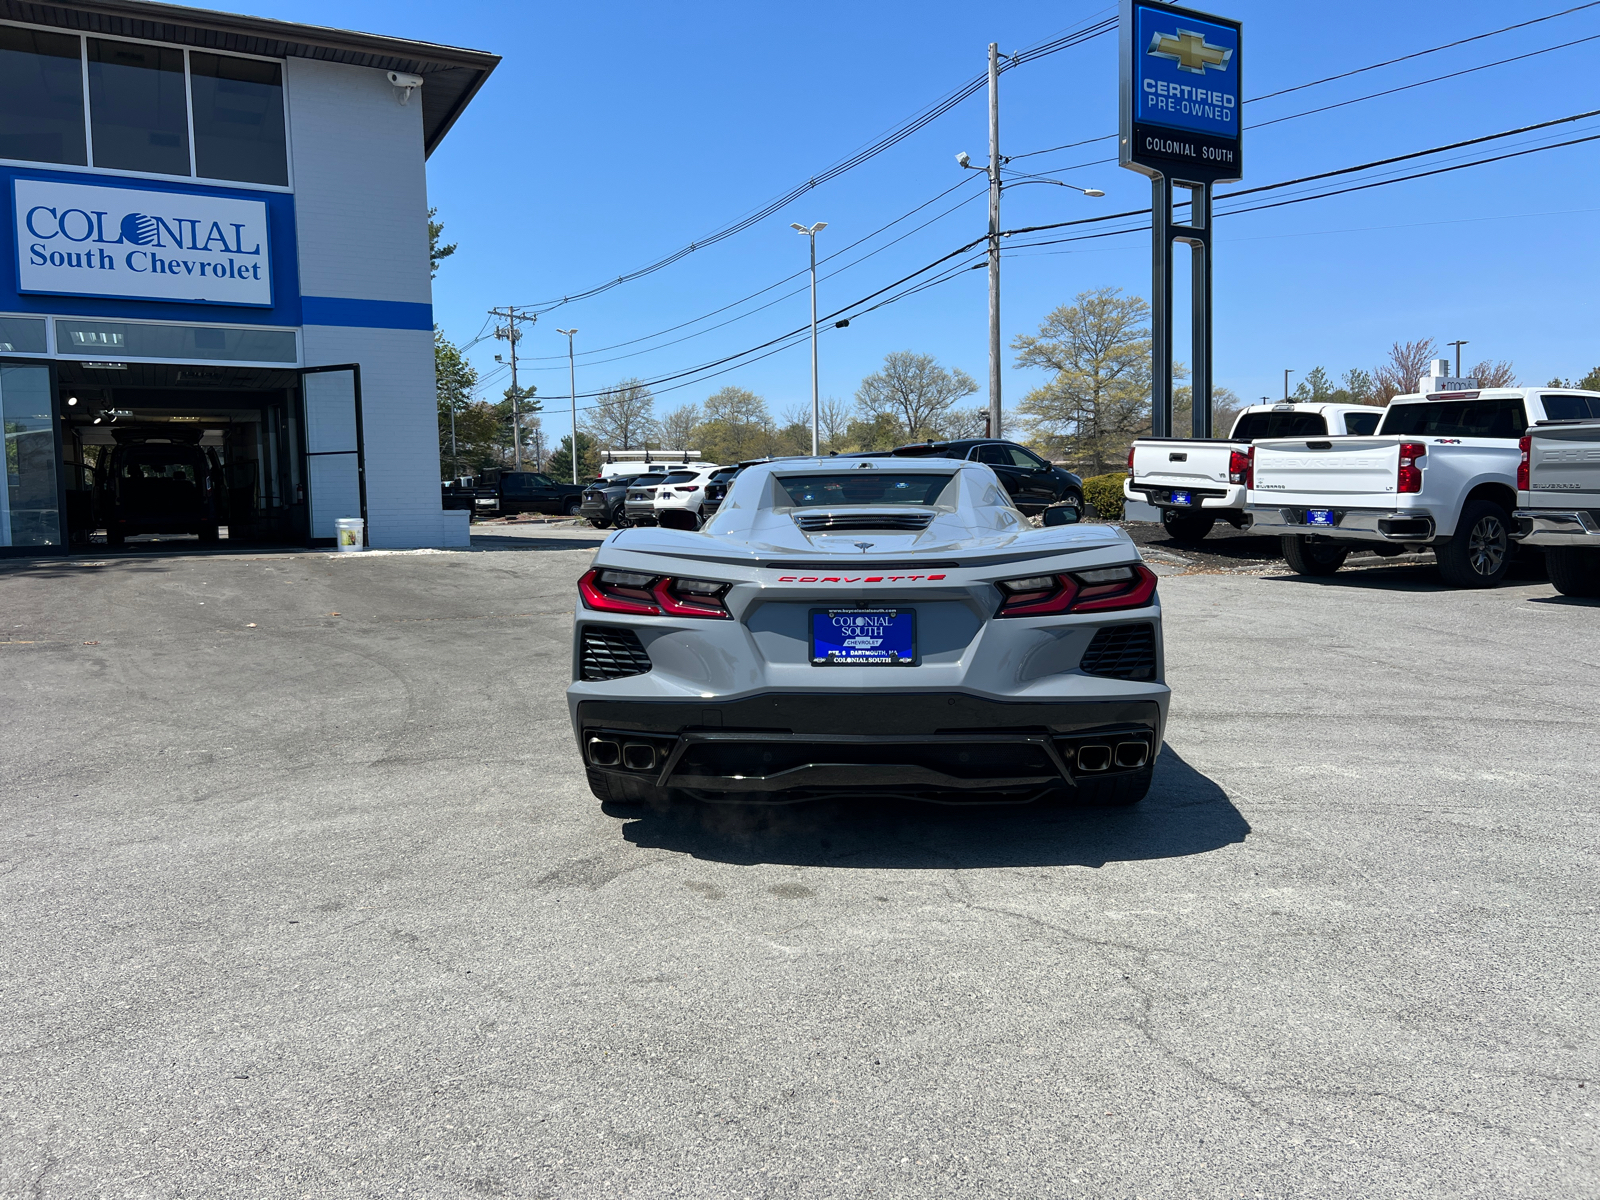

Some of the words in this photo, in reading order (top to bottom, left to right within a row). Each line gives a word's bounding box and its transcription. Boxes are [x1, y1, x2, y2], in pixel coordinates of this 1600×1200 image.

[1143, 78, 1235, 108] CERTIFIED
[1148, 95, 1231, 122] PRE-OWNED
[1146, 137, 1196, 157] COLONIAL
[1202, 146, 1233, 163] SOUTH
[26, 205, 261, 256] COLONIAL
[29, 243, 116, 271] South
[125, 250, 262, 281] Chevrolet
[1260, 457, 1386, 469] CHEVROLET
[778, 574, 947, 583] CORVETTE
[832, 616, 893, 627] COLONIAL
[841, 626, 884, 636] SOUTH
